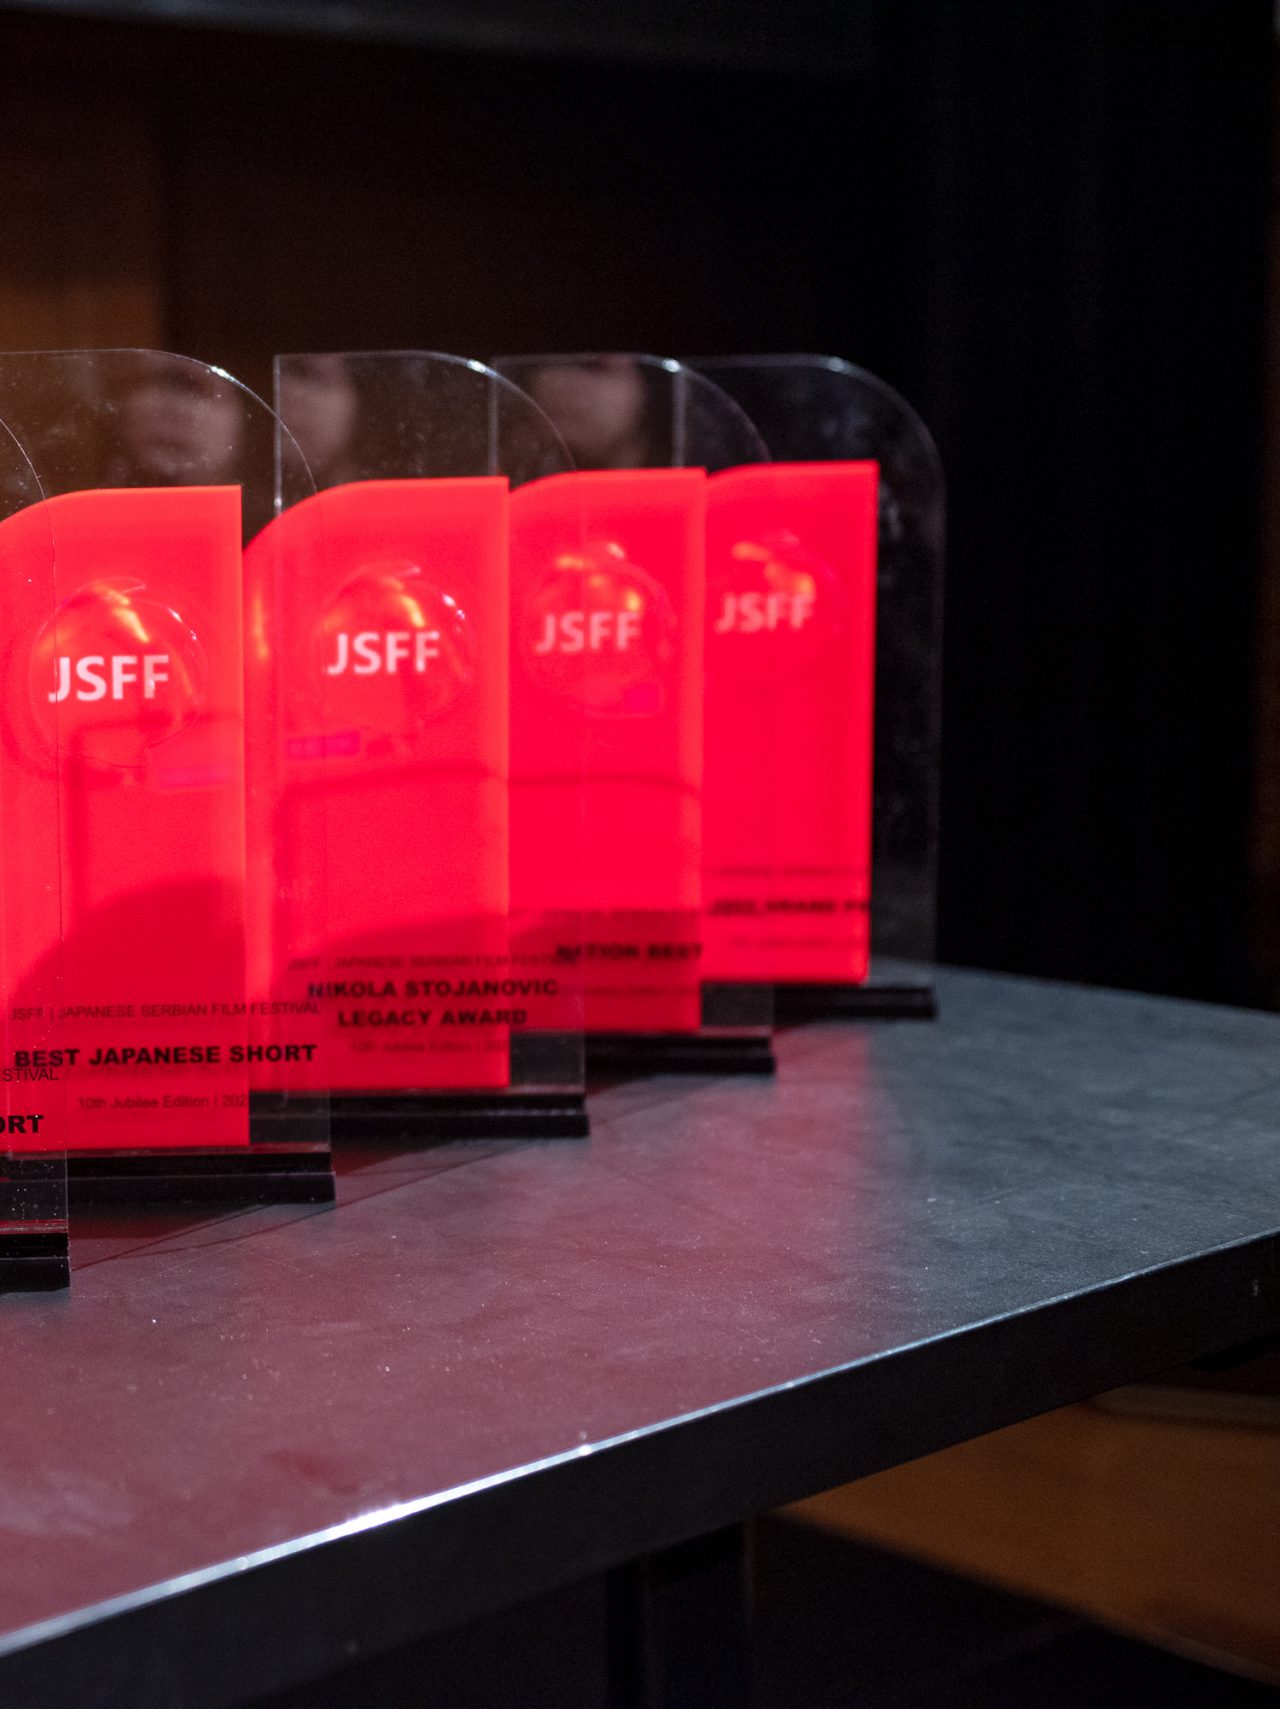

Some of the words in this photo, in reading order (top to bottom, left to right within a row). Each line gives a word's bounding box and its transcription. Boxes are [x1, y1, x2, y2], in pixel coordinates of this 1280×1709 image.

[716, 592, 814, 634] JSFF
[535, 612, 641, 654] JSFF
[326, 631, 440, 676] JSFF
[48, 654, 170, 703] JSFF
[475, 955, 508, 968] FILM
[308, 980, 397, 999] NIKOLA
[405, 978, 558, 998] STOJANOVIC
[10, 1007, 44, 1021] JSFF
[58, 1004, 136, 1019] JAPANESE
[141, 1003, 207, 1017] SERBIAN
[212, 1002, 247, 1016] FILM
[250, 1001, 320, 1016] FESTIVAL
[337, 1009, 432, 1028] LEGACY
[440, 1008, 528, 1026] AWARD
[14, 1049, 80, 1068] BEST
[89, 1046, 221, 1066] JAPANESE
[229, 1044, 318, 1063] SHORT
[79, 1097, 106, 1110] 10th
[110, 1096, 158, 1109] Jubilee
[163, 1095, 209, 1108] Edition
